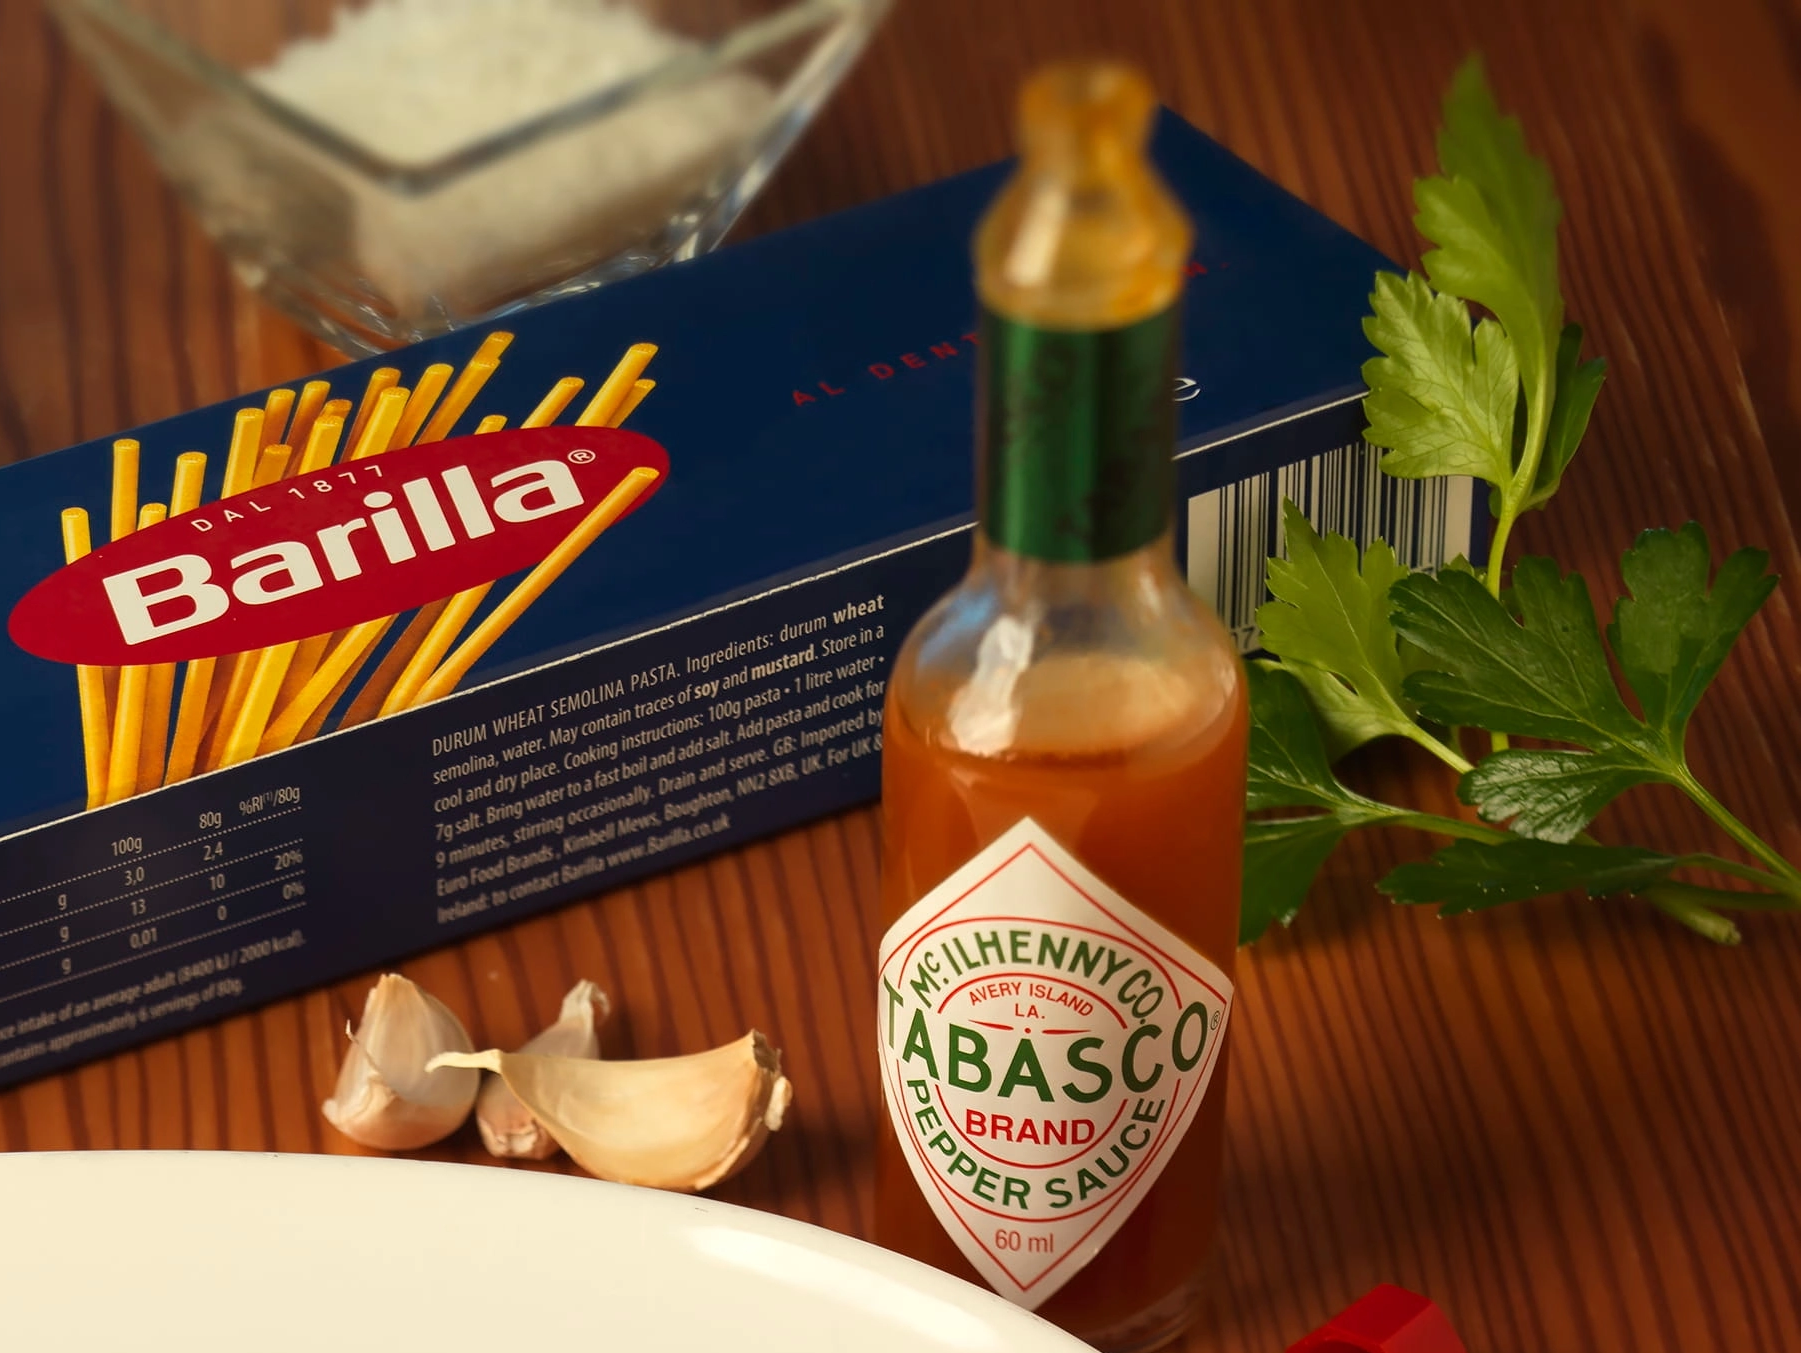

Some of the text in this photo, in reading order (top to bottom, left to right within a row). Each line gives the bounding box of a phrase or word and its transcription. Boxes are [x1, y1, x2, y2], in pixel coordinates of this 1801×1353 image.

[792, 332, 979, 407] AL DENT
[191, 465, 383, 532] DAL 1877
[432, 594, 884, 756] DURUM WHEAT SEMOLINA PASTA. Ingredients: durum wheat
[433, 625, 884, 785] semolina, water. May contain traces of soy and mustard. Store in a
[434, 655, 875, 813] cool and dry place. Cooking instructions: 100g pasta 1 litre water
[435, 680, 885, 842] 7g salt. Bring water to a fast boil and add salt. Add pasta and cook for
[435, 851, 446, 868] 9
[513, 816, 564, 843] stirring
[567, 785, 655, 825] occasionally.
[659, 771, 696, 795] Drain
[700, 757, 726, 782] and
[729, 749, 770, 772] serve.
[800, 712, 864, 748] Imported
[868, 708, 883, 726] by
[436, 875, 468, 896] Euro
[470, 859, 504, 885] Food
[851, 736, 871, 758] UK
[112, 837, 142, 856] 100g
[199, 811, 222, 829] 80g
[58, 894, 67, 910] g
[125, 866, 144, 886] 3,0
[203, 841, 223, 860] 2,4
[60, 926, 69, 942] g
[131, 899, 146, 916] 13
[210, 873, 225, 891] 10
[274, 850, 303, 871] 20%
[61, 958, 71, 975] g
[217, 905, 227, 920] 0
[883, 974, 1208, 1104] TABASCO
[969, 982, 1093, 1016] AVERY ISLAND
[1015, 1003, 1045, 1019] LA.
[907, 1079, 1165, 1210] PEPPER SAUCE
[966, 1109, 1095, 1145] BRAND
[995, 1229, 1054, 1253] 60 ml
